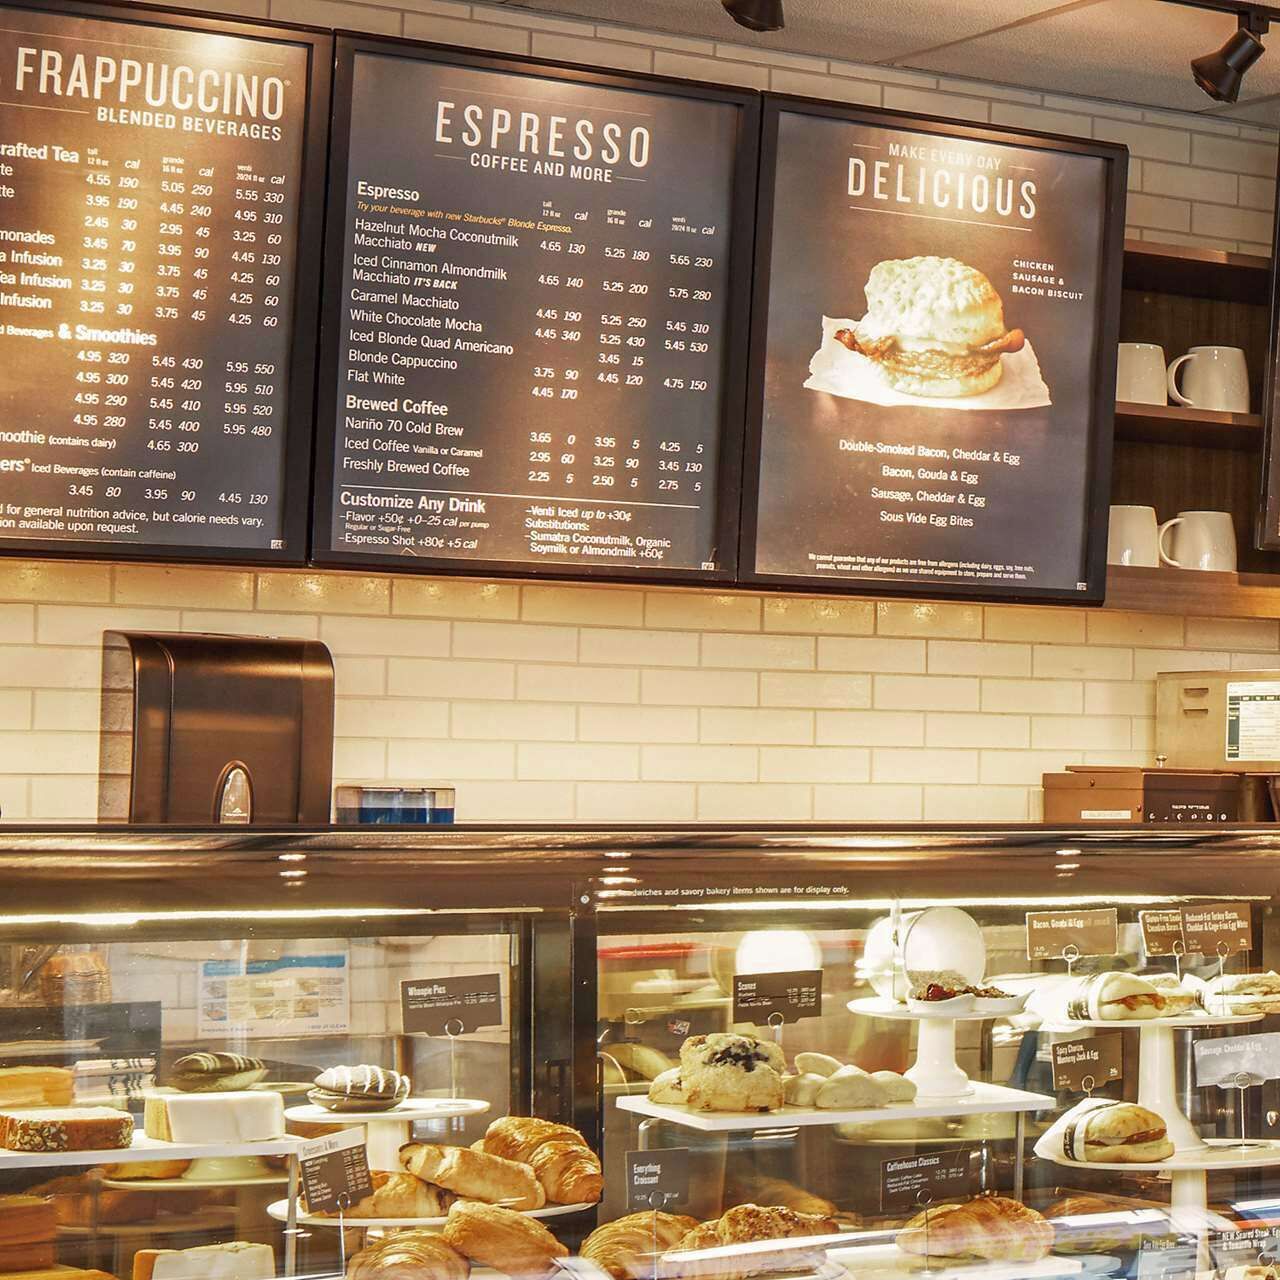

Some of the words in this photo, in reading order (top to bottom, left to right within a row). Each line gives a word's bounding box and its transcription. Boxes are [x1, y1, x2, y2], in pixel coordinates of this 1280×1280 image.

[16, 47, 284, 121] FRAPPUCCINO
[97, 106, 176, 129] BLENDED
[182, 116, 282, 141] BEVERAGES
[435, 101, 650, 168] ESPRESSO
[470, 152, 528, 173] COFFEE
[533, 160, 565, 176] AND
[570, 165, 612, 183] MORE
[889, 143, 926, 159] MAKE
[976, 155, 1001, 171] DAY
[357, 181, 419, 202] Espresso
[848, 157, 1036, 219] DELICIOUS
[1013, 259, 1054, 271] CHICKEN
[1013, 272, 1054, 284] SAUSAGE
[1058, 276, 1064, 285] &
[1012, 285, 1044, 296] BACON
[1048, 289, 1083, 300] BISCUIT
[350, 310, 383, 325] White
[386, 313, 441, 330] Chocolate
[444, 316, 482, 333] Mocha
[346, 394, 398, 413] Brewed
[402, 398, 448, 416] Coffee
[343, 457, 384, 475] Freshly
[387, 460, 429, 474] Brewed
[432, 462, 470, 478] Coffee
[340, 491, 413, 508] Customize
[418, 495, 445, 513] Any
[449, 497, 486, 514] Drink
[7, 505, 21, 517] for
[24, 506, 63, 520] general
[66, 508, 109, 520] nutrition
[112, 510, 149, 522] advice,
[152, 511, 170, 523] but
[172, 512, 206, 524] calorie
[209, 514, 238, 526] needs
[242, 516, 265, 528] vary.
[880, 511, 904, 524] Sous
[906, 512, 927, 525] Vide
[930, 514, 948, 527] Egg
[950, 516, 973, 527] Bites
[432, 984, 446, 995] Pies
